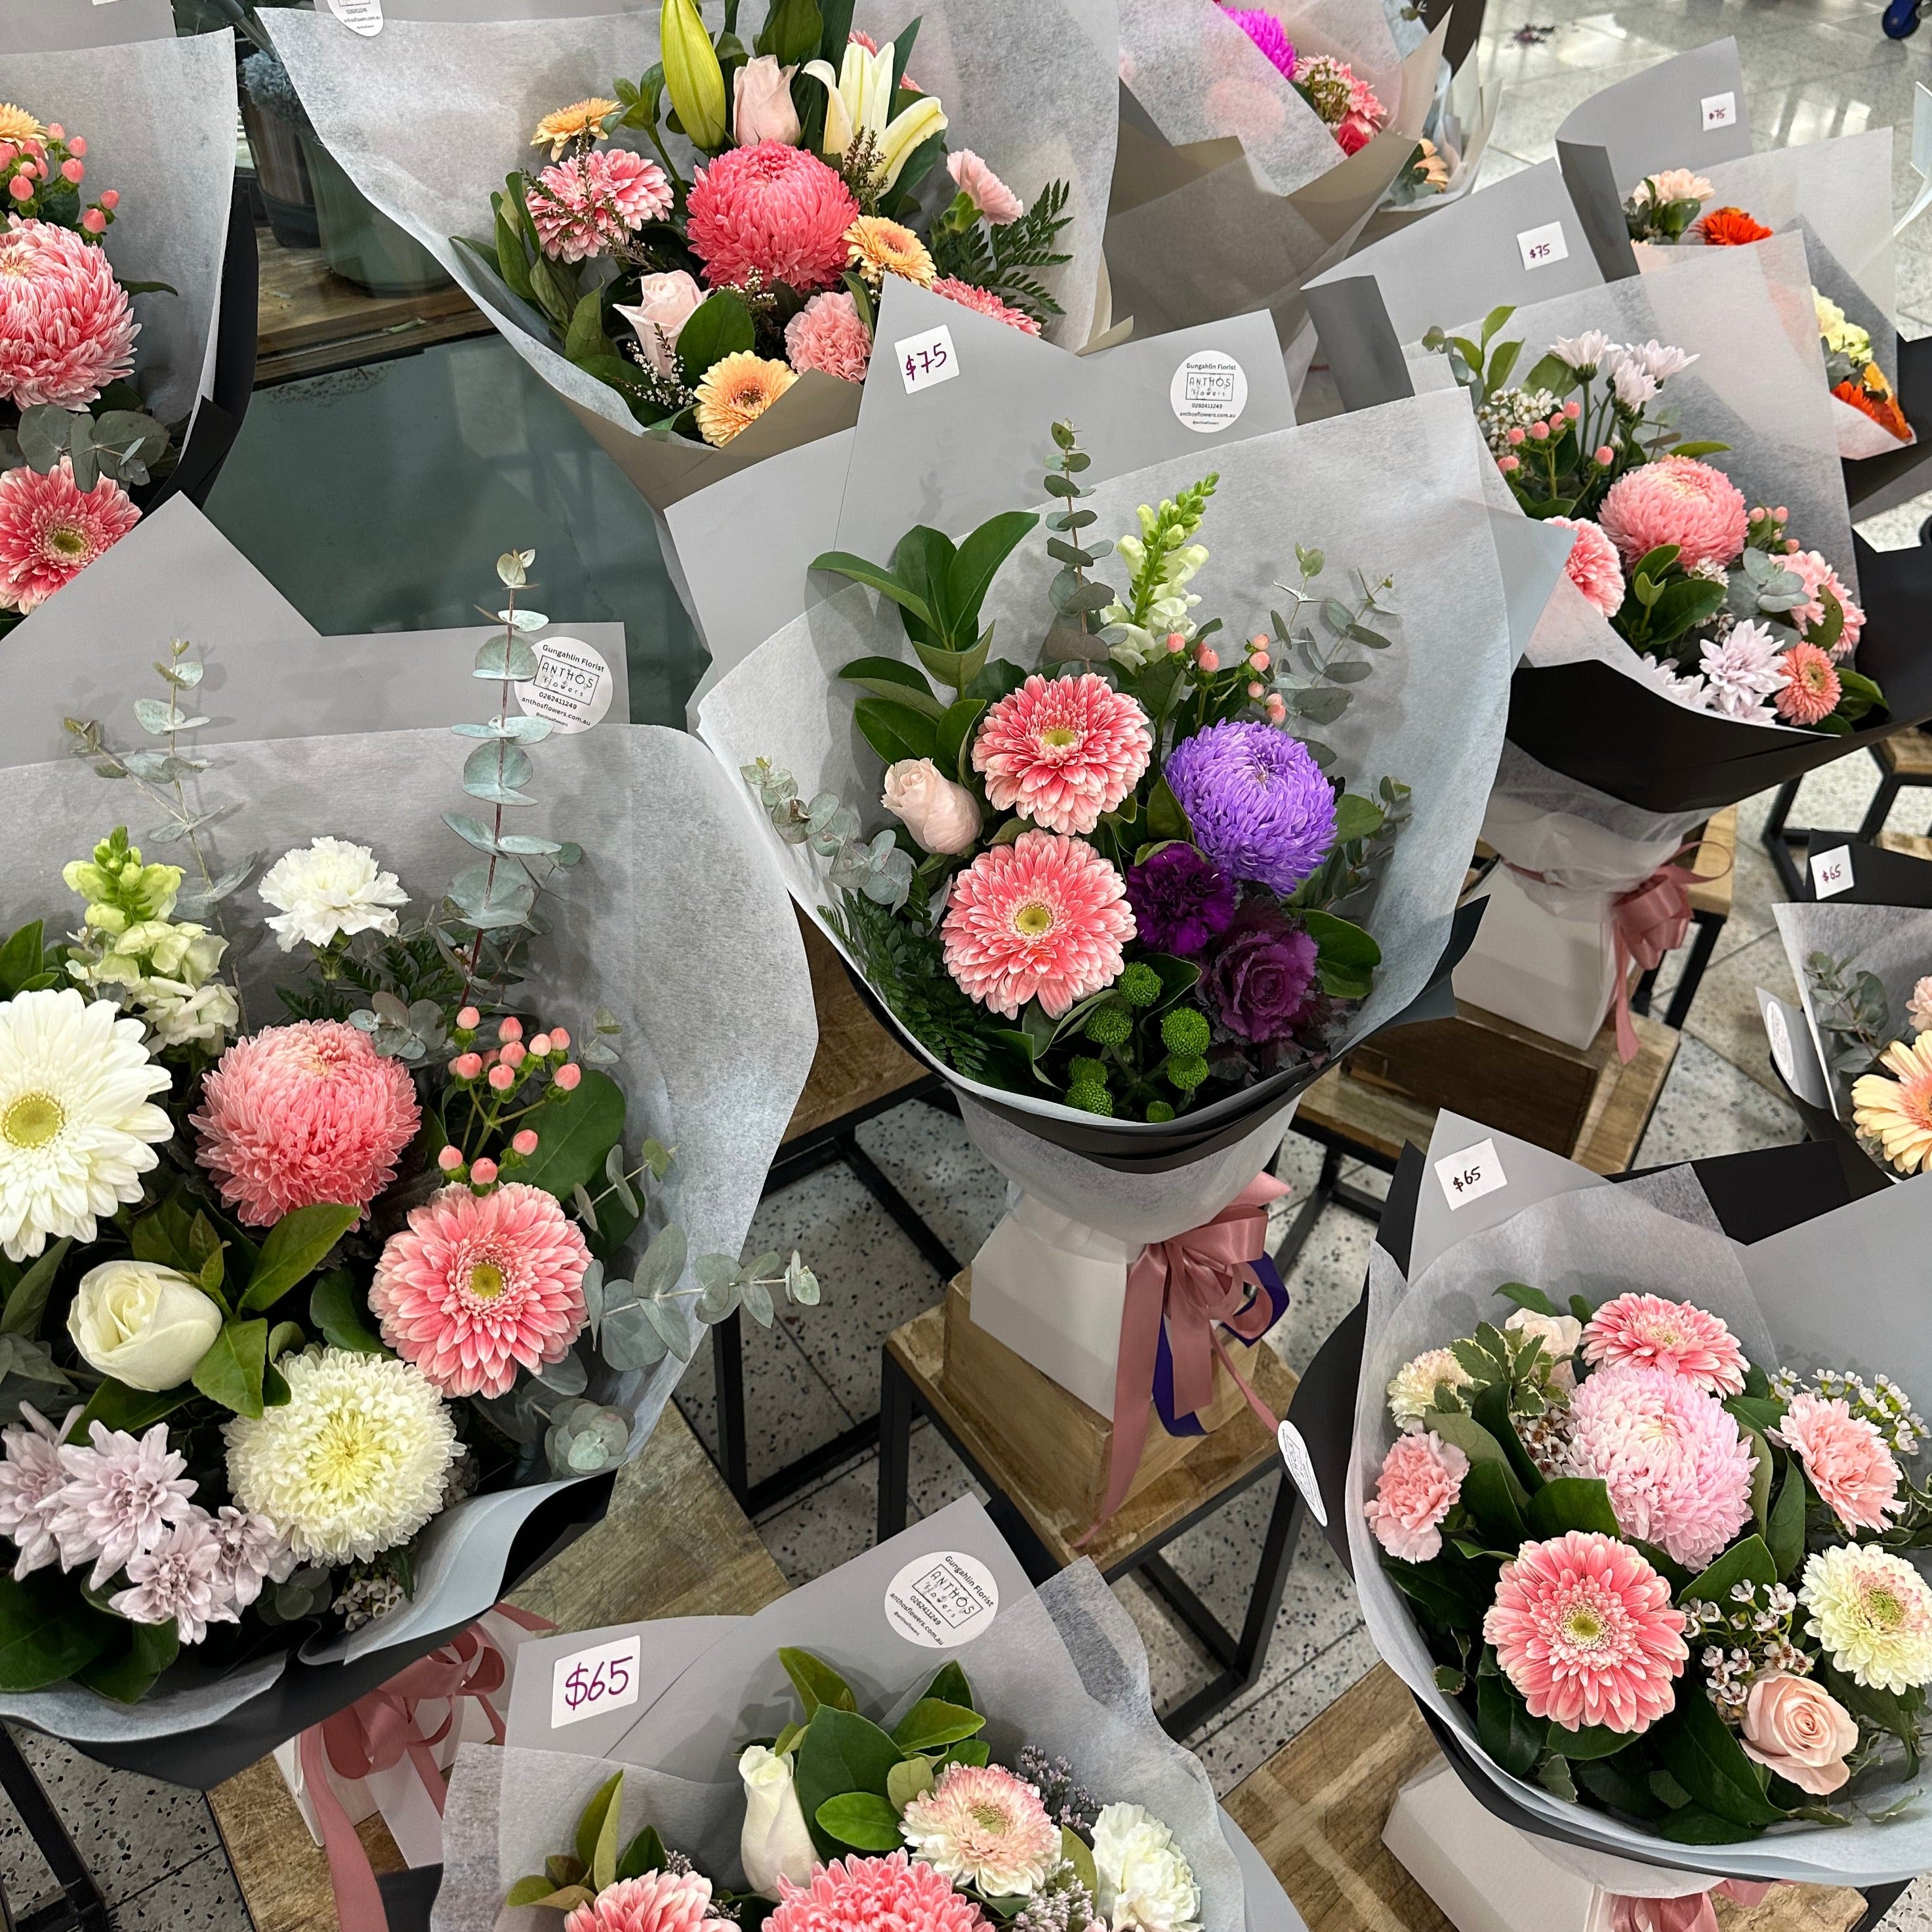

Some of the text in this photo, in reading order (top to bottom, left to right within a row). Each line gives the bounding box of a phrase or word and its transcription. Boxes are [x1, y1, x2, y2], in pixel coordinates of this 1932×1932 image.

[1529, 243, 1550, 258] $75
[906, 342, 947, 381] $75
[1189, 377, 1231, 387] ANTHOS
[543, 644, 604, 672] Gungahlin Florist
[542, 662, 593, 688] ANTHOS
[544, 676, 583, 697] flowers
[522, 697, 590, 726] anthosflowers.com.au
[539, 691, 577, 710] 0262411249
[1822, 863, 1840, 882] $65
[1453, 1166, 1481, 1192] $65
[930, 1571, 975, 1614] ANTHOS
[945, 1555, 994, 1607] Gungahlin Florist
[910, 1595, 941, 1626] 0262411249
[924, 1584, 956, 1618] flowers
[890, 1593, 944, 1645] anthosflowers.com.au
[565, 1656, 633, 1711] $65
